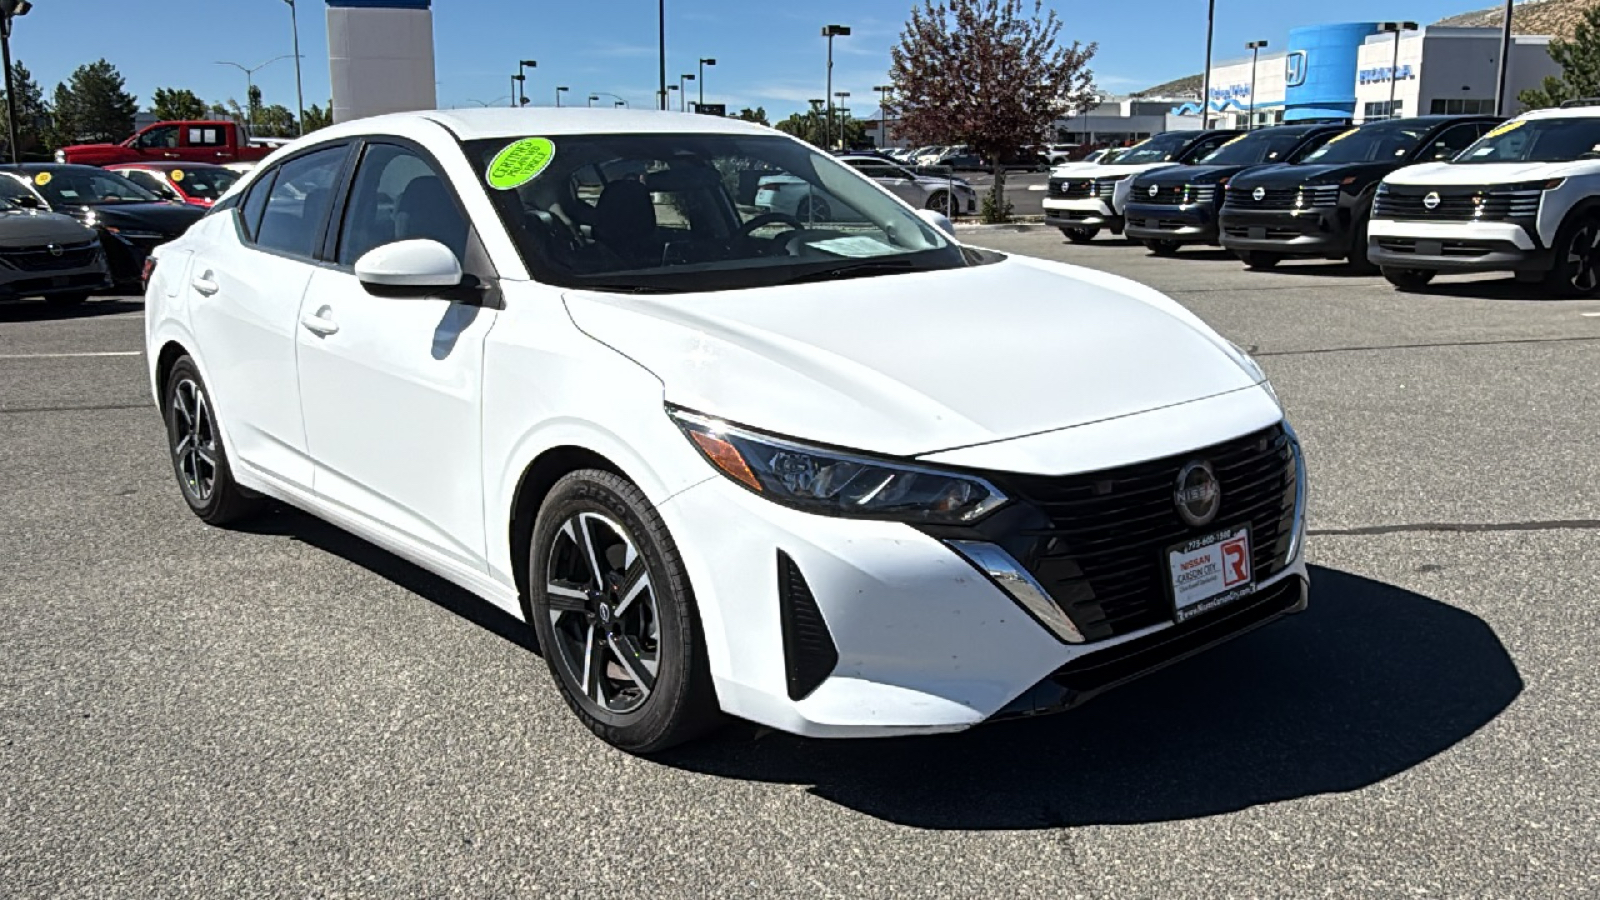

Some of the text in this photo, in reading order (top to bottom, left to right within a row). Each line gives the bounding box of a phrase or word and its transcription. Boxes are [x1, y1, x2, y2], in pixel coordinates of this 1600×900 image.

[1180, 554, 1211, 571] NISSAN
[1177, 567, 1203, 585] CARSON
[1203, 563, 1216, 576] CITY
